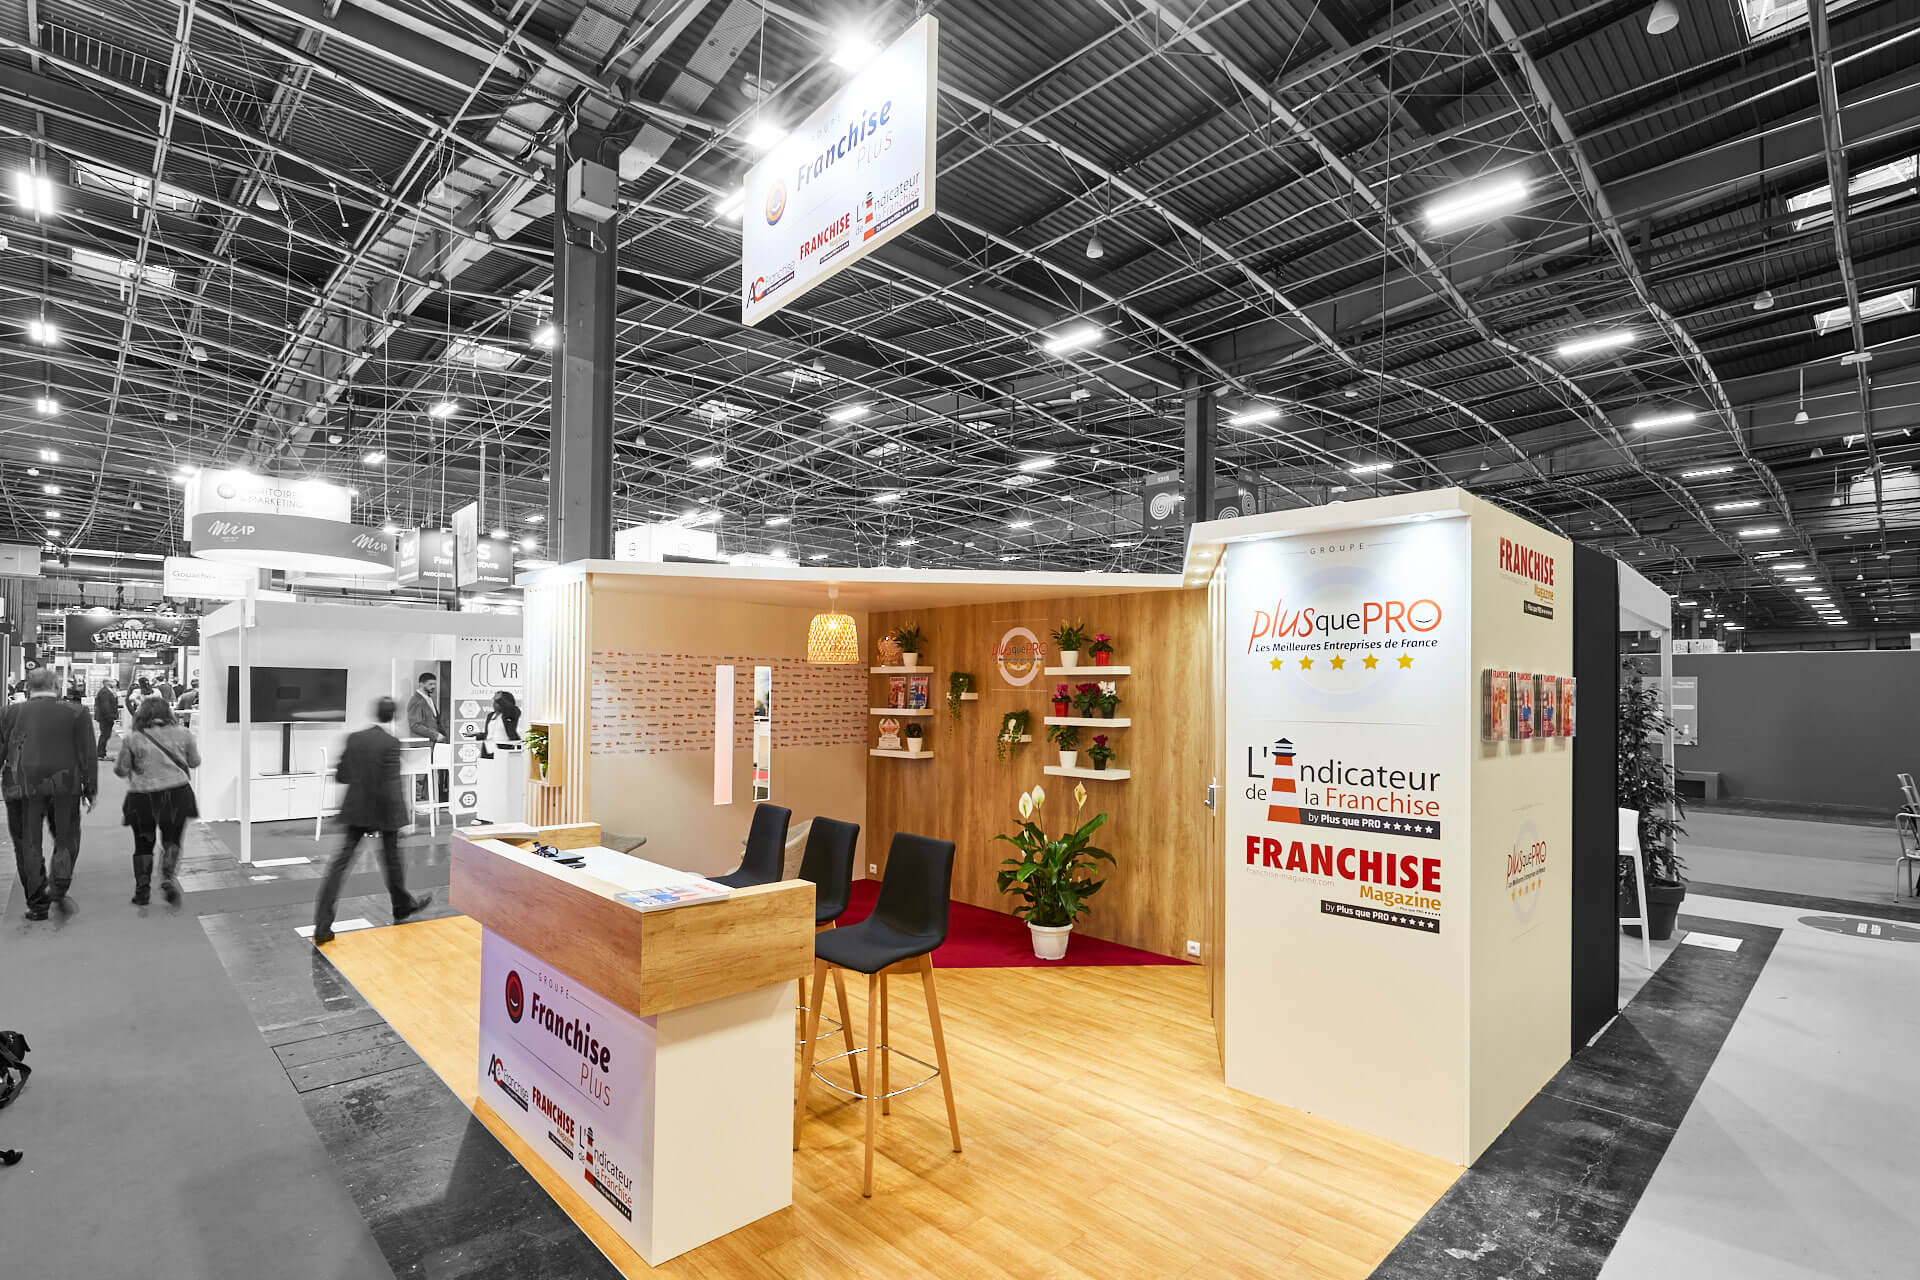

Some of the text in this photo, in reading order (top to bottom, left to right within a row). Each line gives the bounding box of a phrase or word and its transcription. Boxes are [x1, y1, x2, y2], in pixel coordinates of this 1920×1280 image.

[796, 100, 893, 191] Franchise
[800, 212, 850, 260] FRANCHISE
[1310, 542, 1365, 555] GROUPE
[1499, 536, 1554, 586] FRANCHISE
[93, 630, 173, 644] EXPERIMENTAL
[119, 639, 148, 649] PARK
[1255, 638, 1438, 653] Les Meilleures Entreprises de France
[500, 662, 518, 679] VR
[1245, 783, 1440, 817] de la Franchise
[1308, 812, 1381, 829] by Plus que PRO
[1246, 835, 1441, 893] FRANCHISE
[1325, 903, 1389, 921] by Plus que PRO
[1359, 884, 1441, 911] Magazine
[531, 992, 611, 1073] Franchise
[532, 1086, 575, 1139] FRANCHISE
[600, 1167, 632, 1208] Franchise
